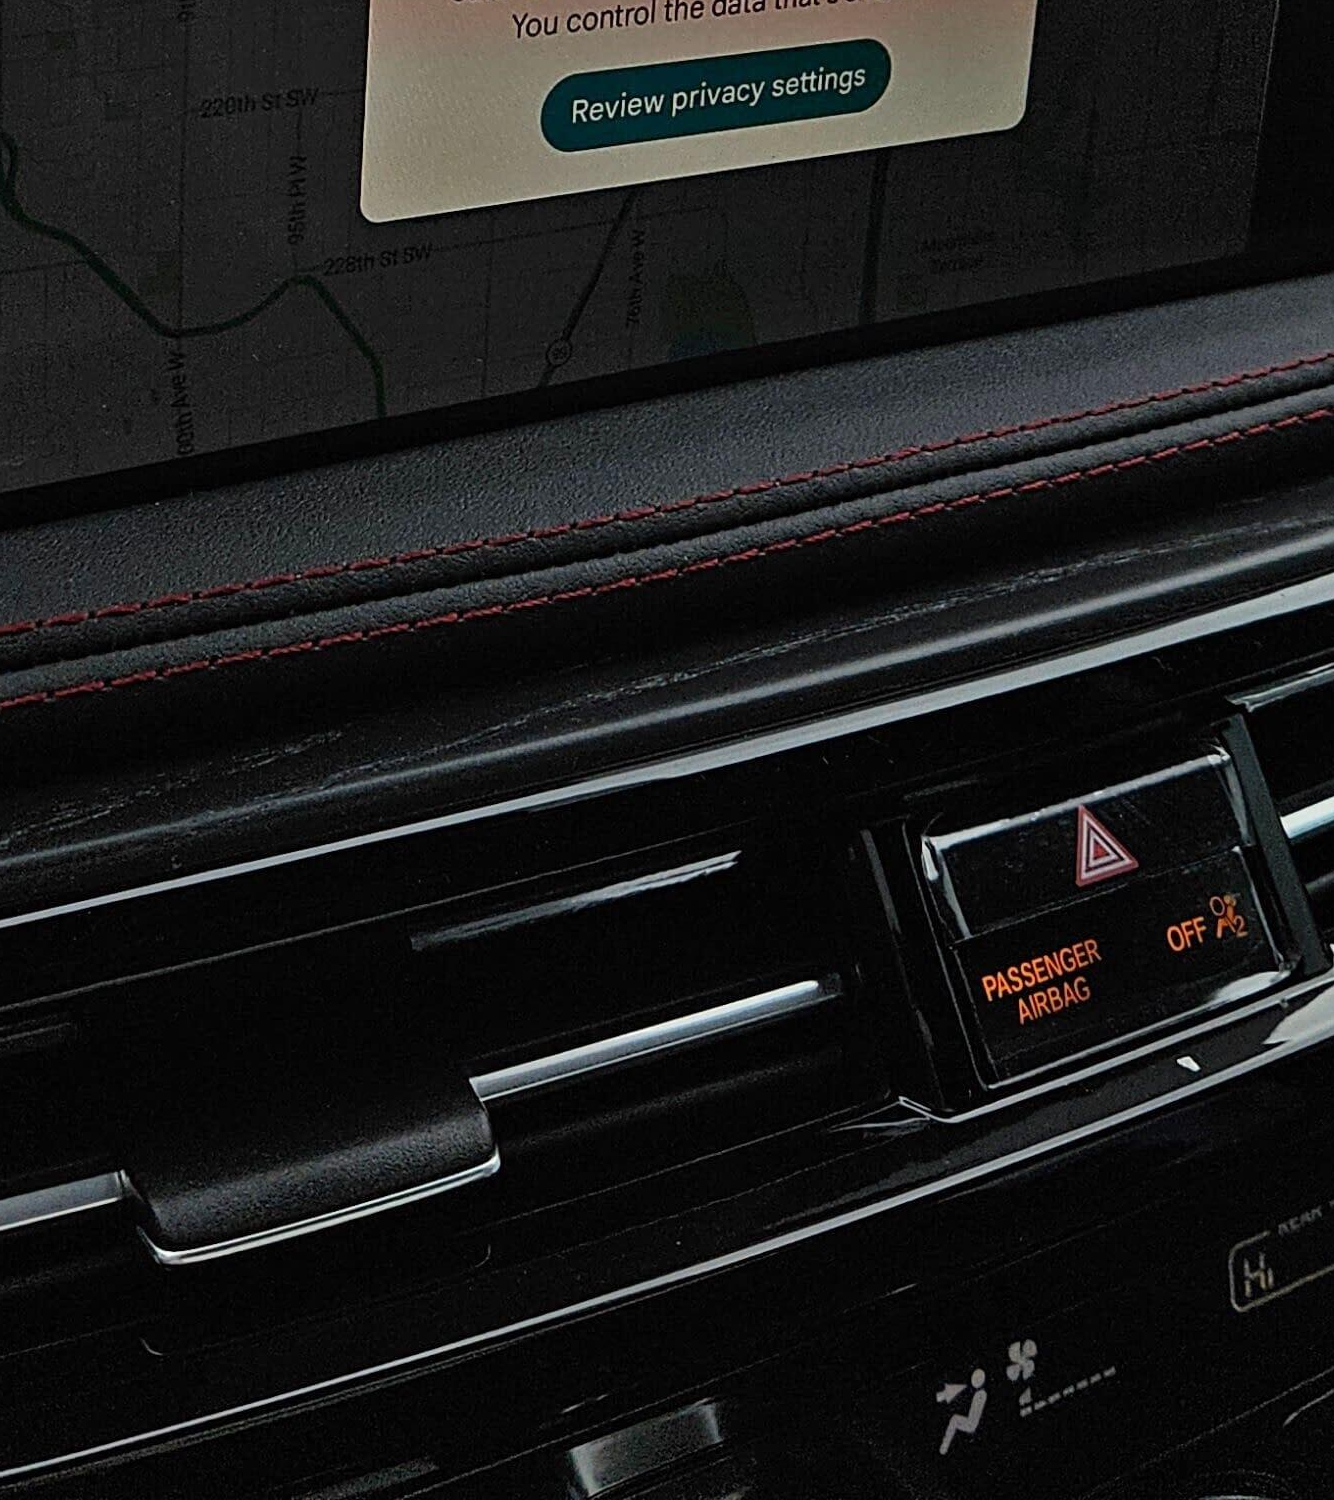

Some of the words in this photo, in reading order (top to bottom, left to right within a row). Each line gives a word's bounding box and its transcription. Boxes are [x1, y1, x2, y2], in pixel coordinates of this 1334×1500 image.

[513, 12, 559, 42] You
[566, 1, 656, 37] control
[261, 92, 281, 112] St
[285, 87, 319, 108] SW
[571, 89, 665, 126] Review
[671, 75, 765, 119] privacy
[771, 64, 867, 102] settings
[1166, 915, 1207, 953] OFF
[982, 938, 1102, 1003] PASSENGER
[1017, 976, 1091, 1026] AIRBAG
